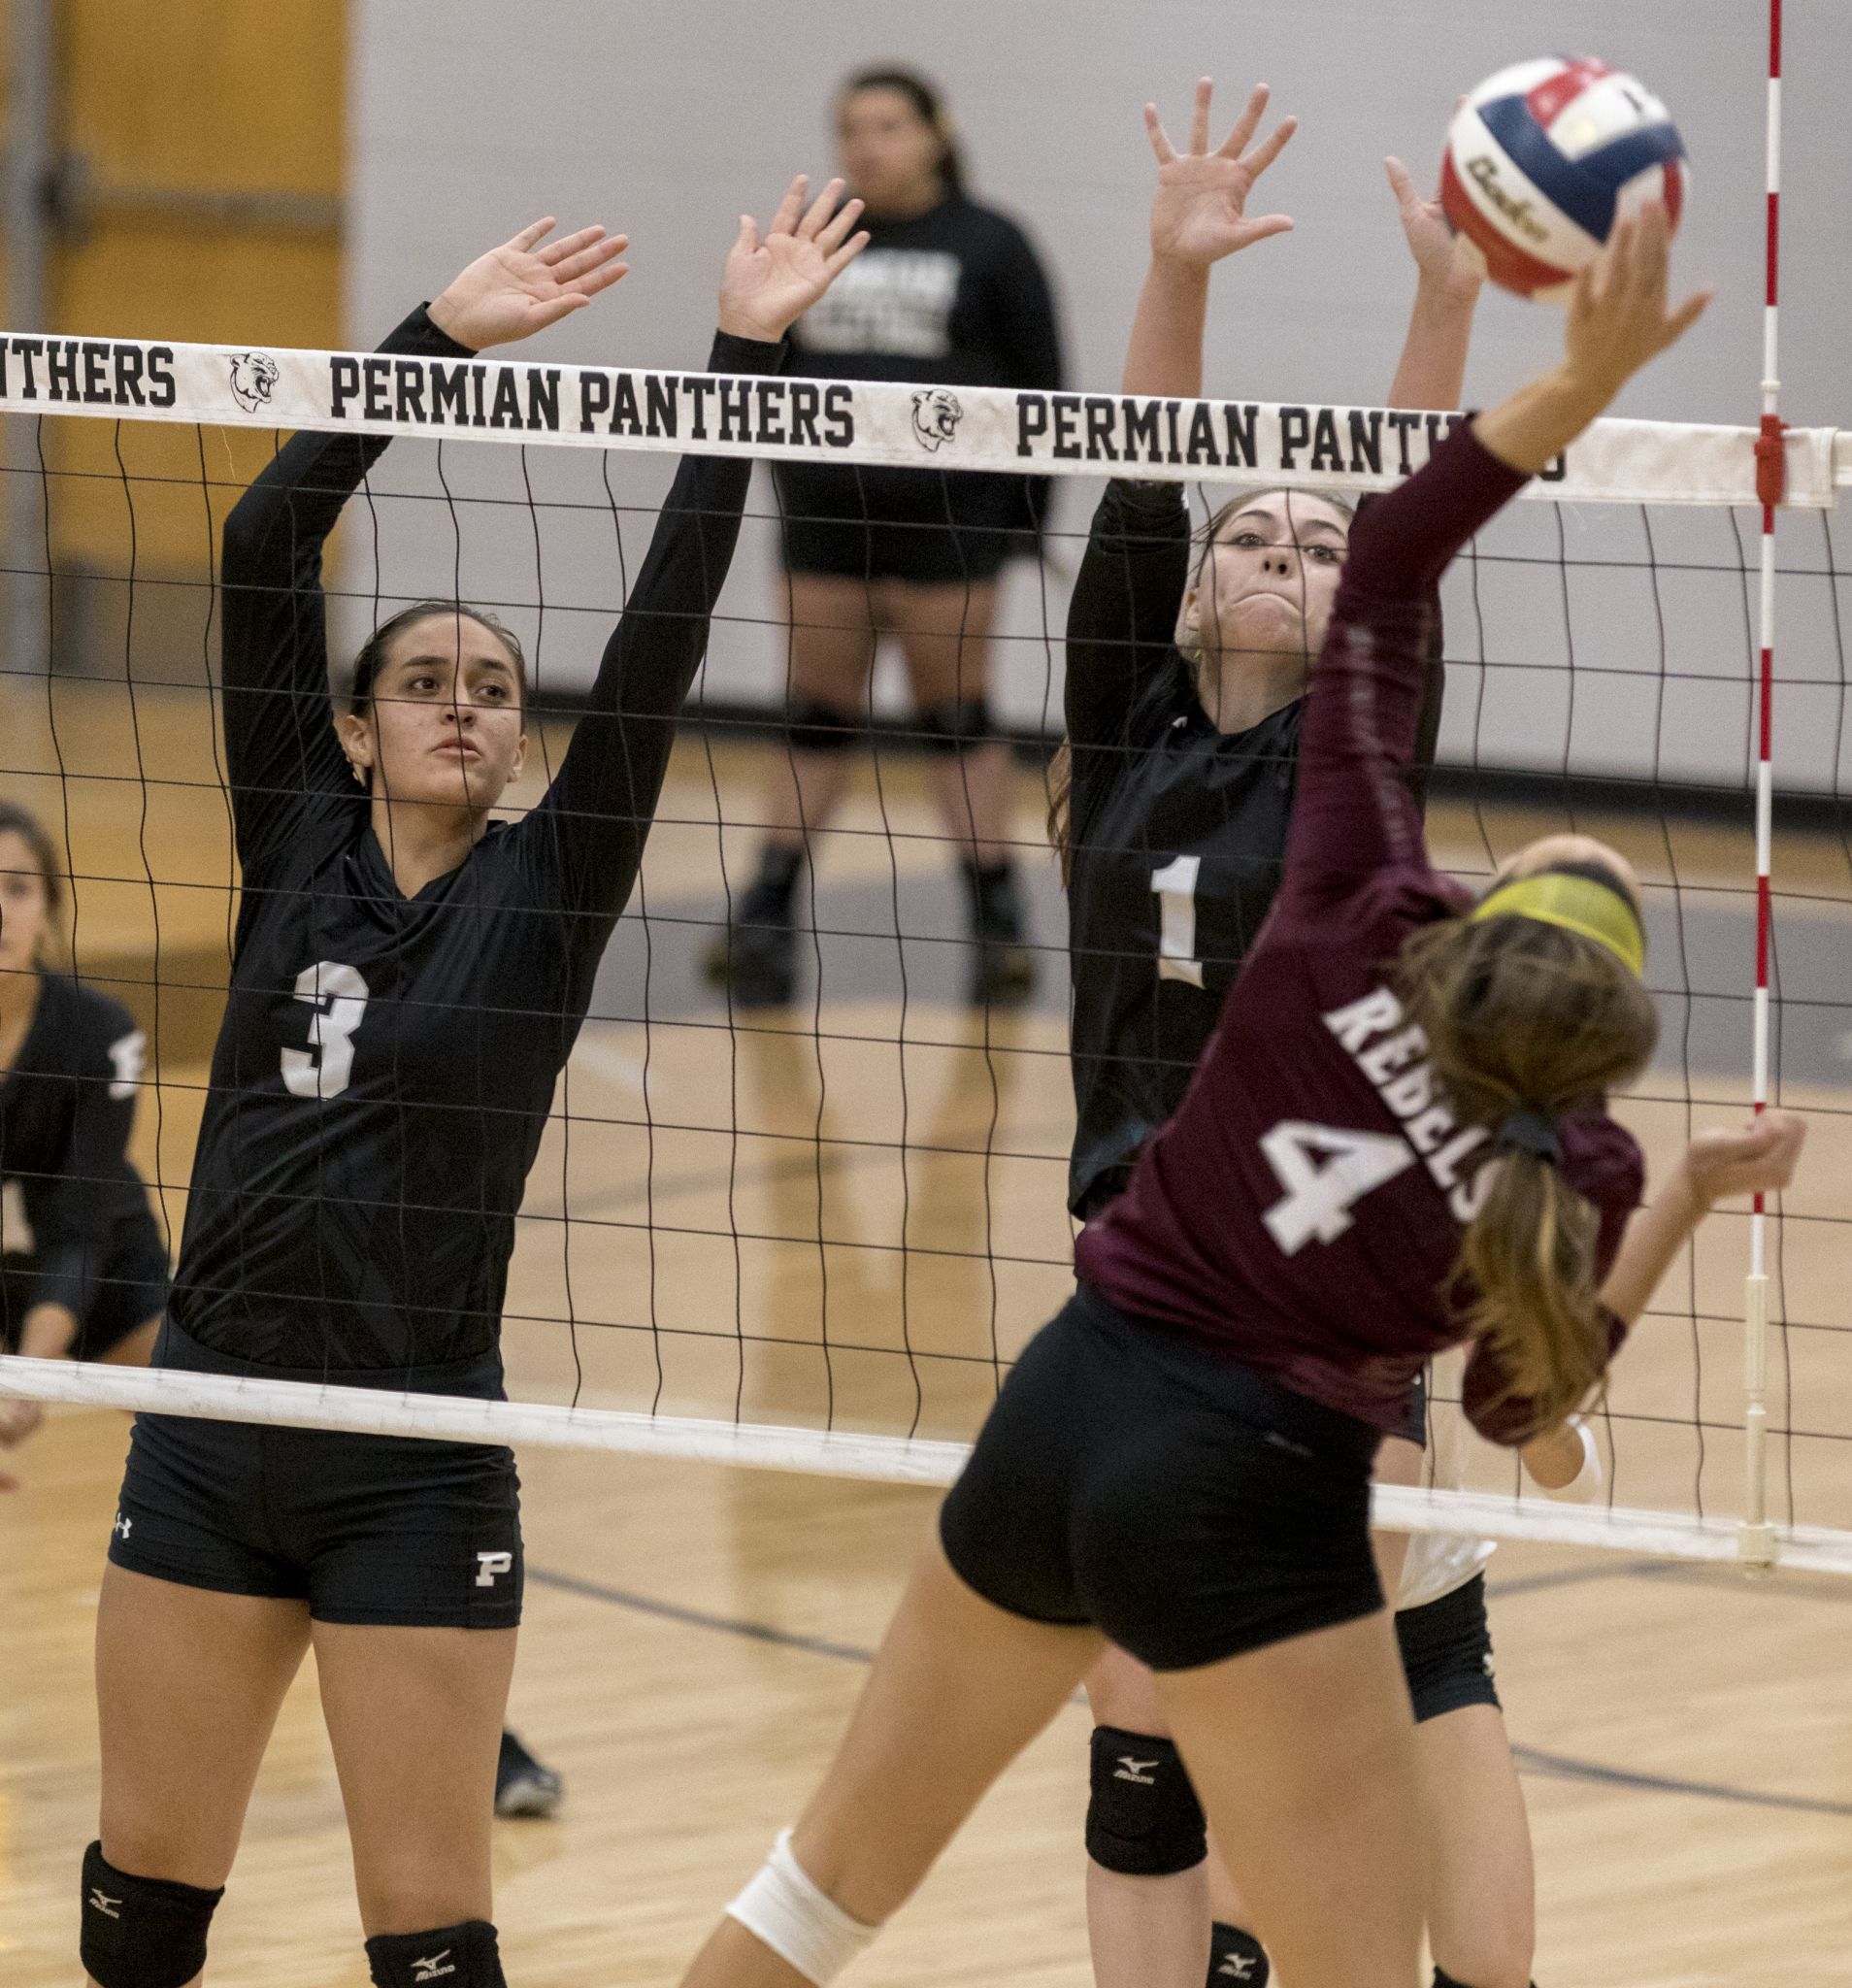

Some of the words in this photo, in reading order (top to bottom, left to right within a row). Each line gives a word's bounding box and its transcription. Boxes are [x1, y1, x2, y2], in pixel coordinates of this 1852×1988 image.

[0, 337, 176, 408] THERS
[330, 356, 561, 430] PERMIAN
[579, 371, 855, 447] PANTHERS
[1017, 394, 1259, 469] PERMIAN
[1151, 855, 1206, 989] 1
[281, 961, 369, 1101] 3
[1260, 1120, 1415, 1256] 4
[476, 1552, 513, 1586] P
